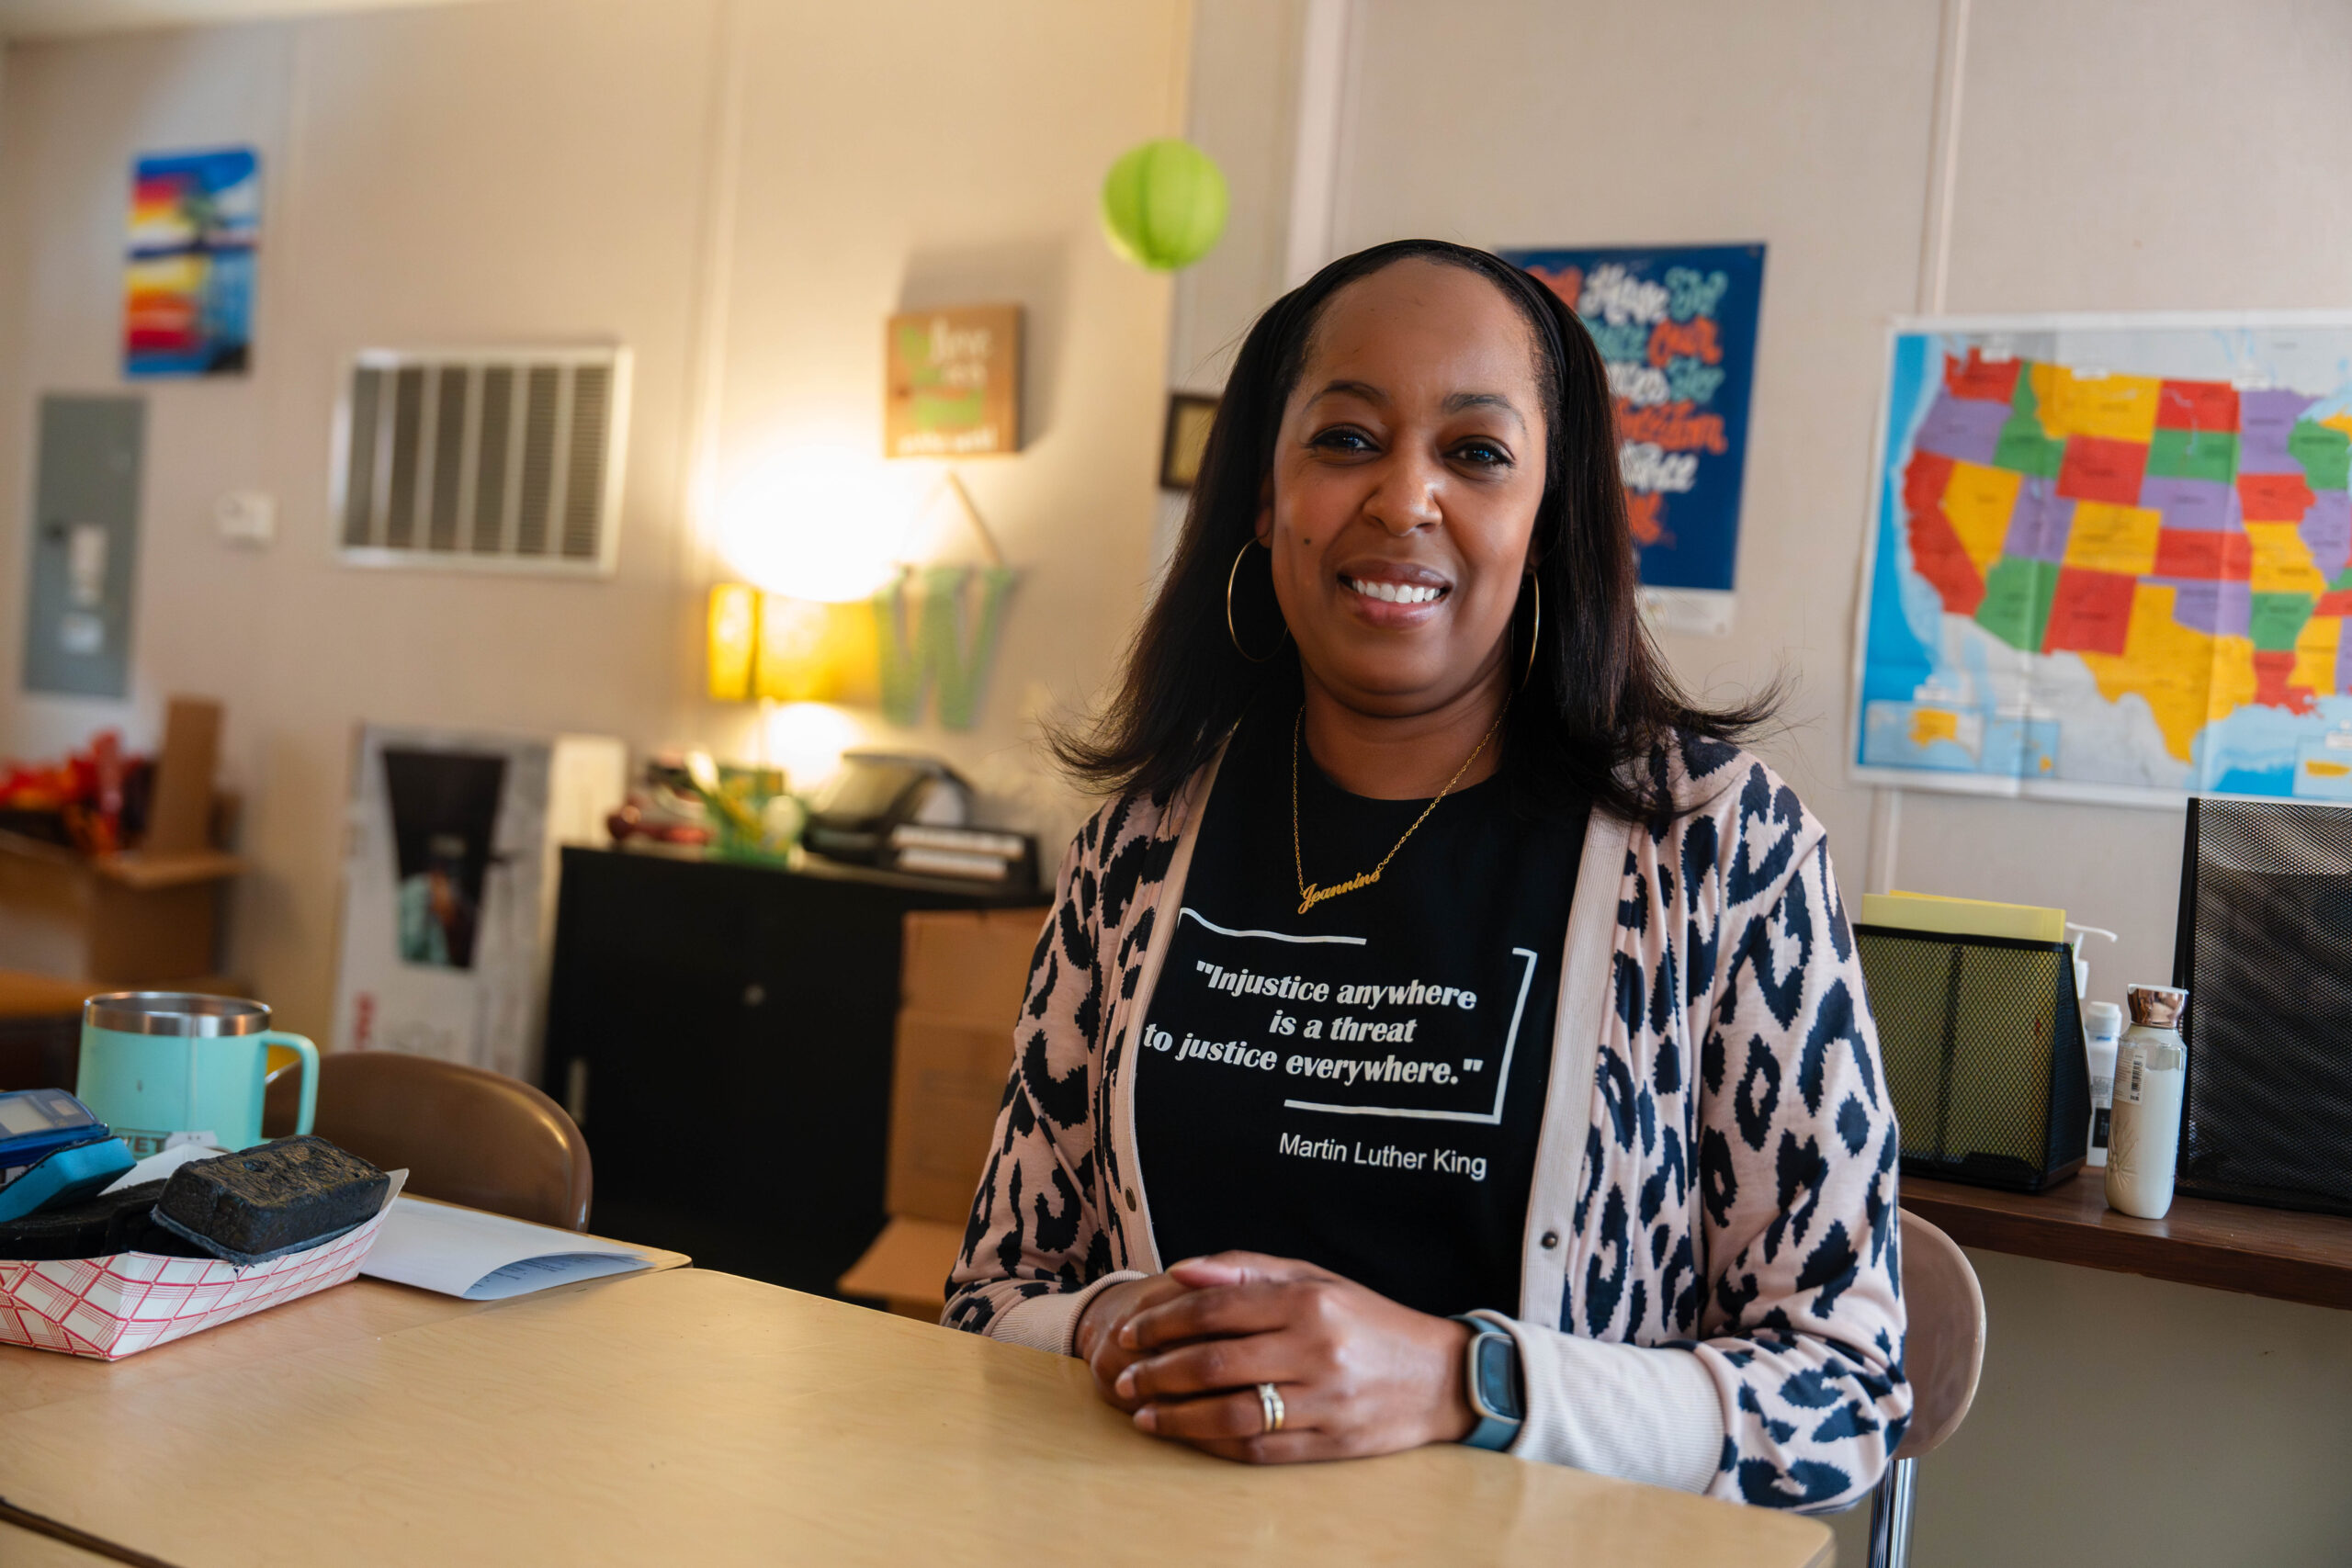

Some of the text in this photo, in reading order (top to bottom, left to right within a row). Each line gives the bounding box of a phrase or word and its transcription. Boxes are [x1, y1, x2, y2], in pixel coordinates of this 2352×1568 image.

[1298, 872, 1380, 914] Jeannine
[1196, 961, 1476, 1010] "Injustice anywhere
[1270, 1010, 1417, 1043] is a threat
[1143, 1022, 1483, 1086] to justice everywhere."
[1280, 1133, 1486, 1180] Martin Luther King
